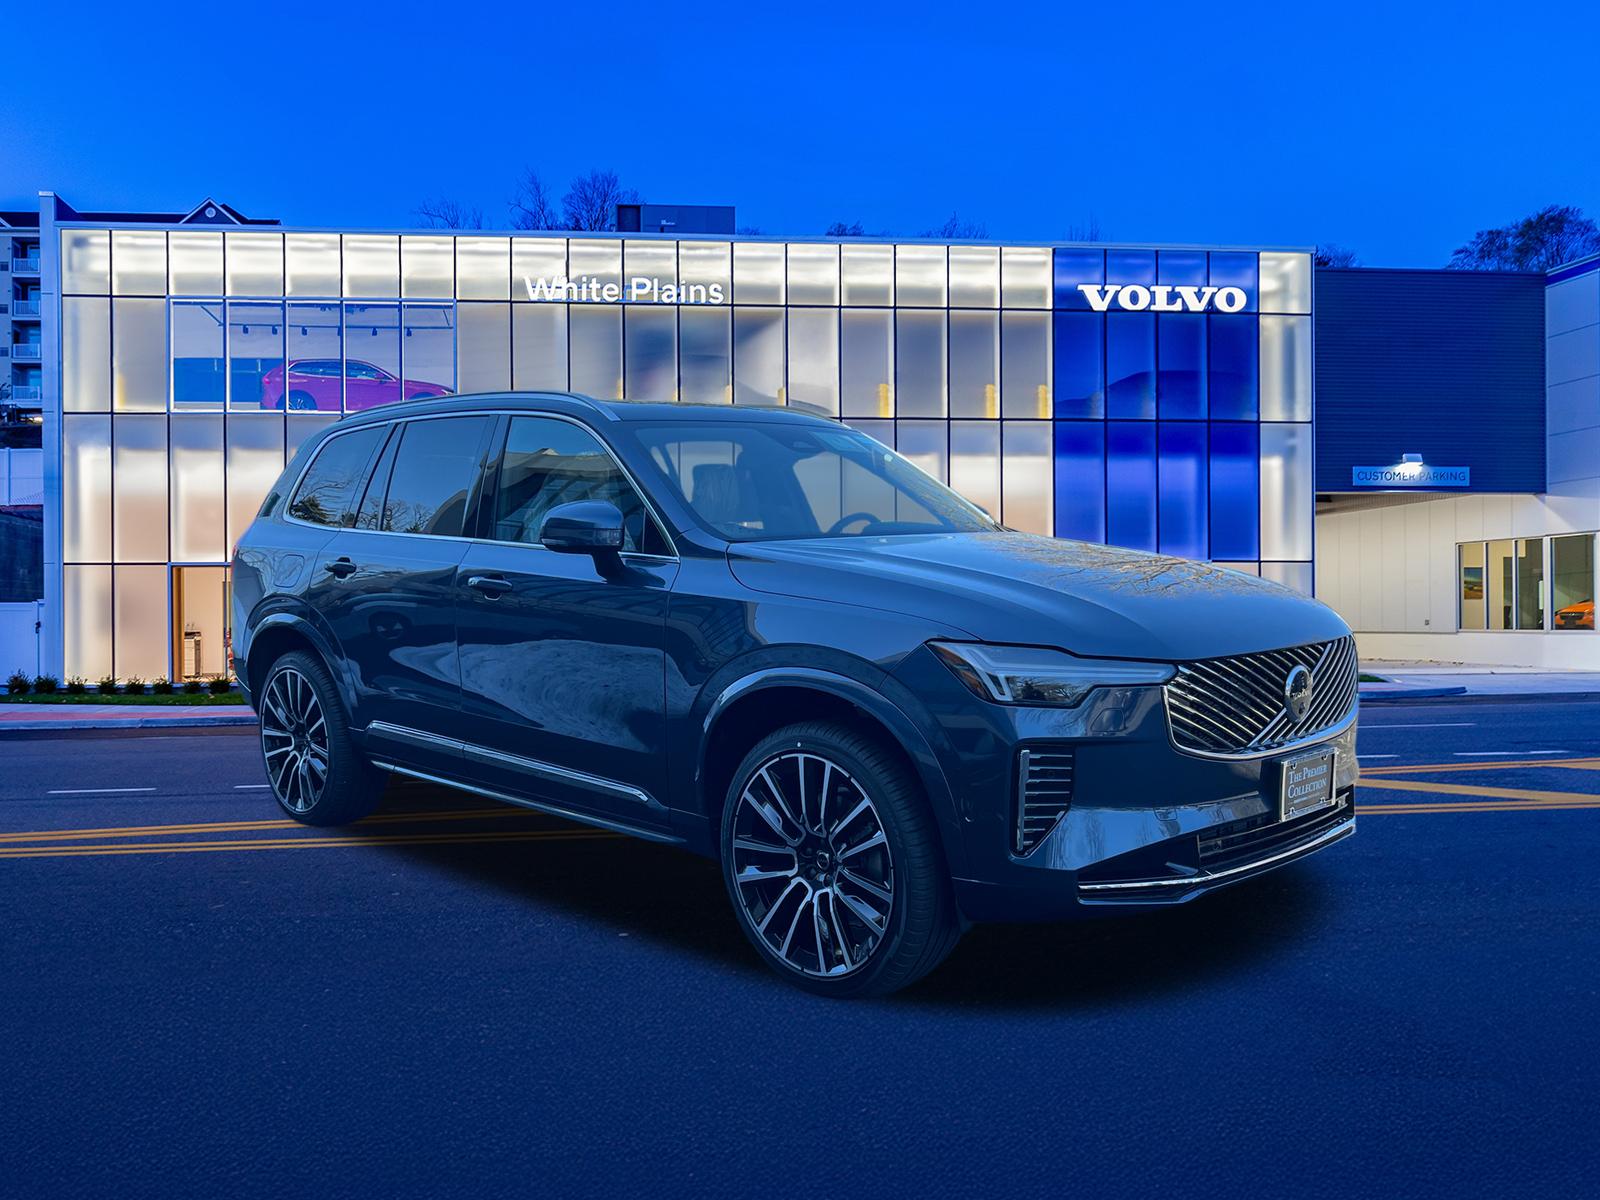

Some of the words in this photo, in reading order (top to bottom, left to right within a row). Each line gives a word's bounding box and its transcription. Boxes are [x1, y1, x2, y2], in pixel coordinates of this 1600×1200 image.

[524, 275, 619, 302] White
[631, 277, 725, 304] Plains
[1077, 284, 1247, 313] VOLVO
[1357, 471, 1416, 482] CUSTOMER
[1419, 471, 1466, 481] PARKING
